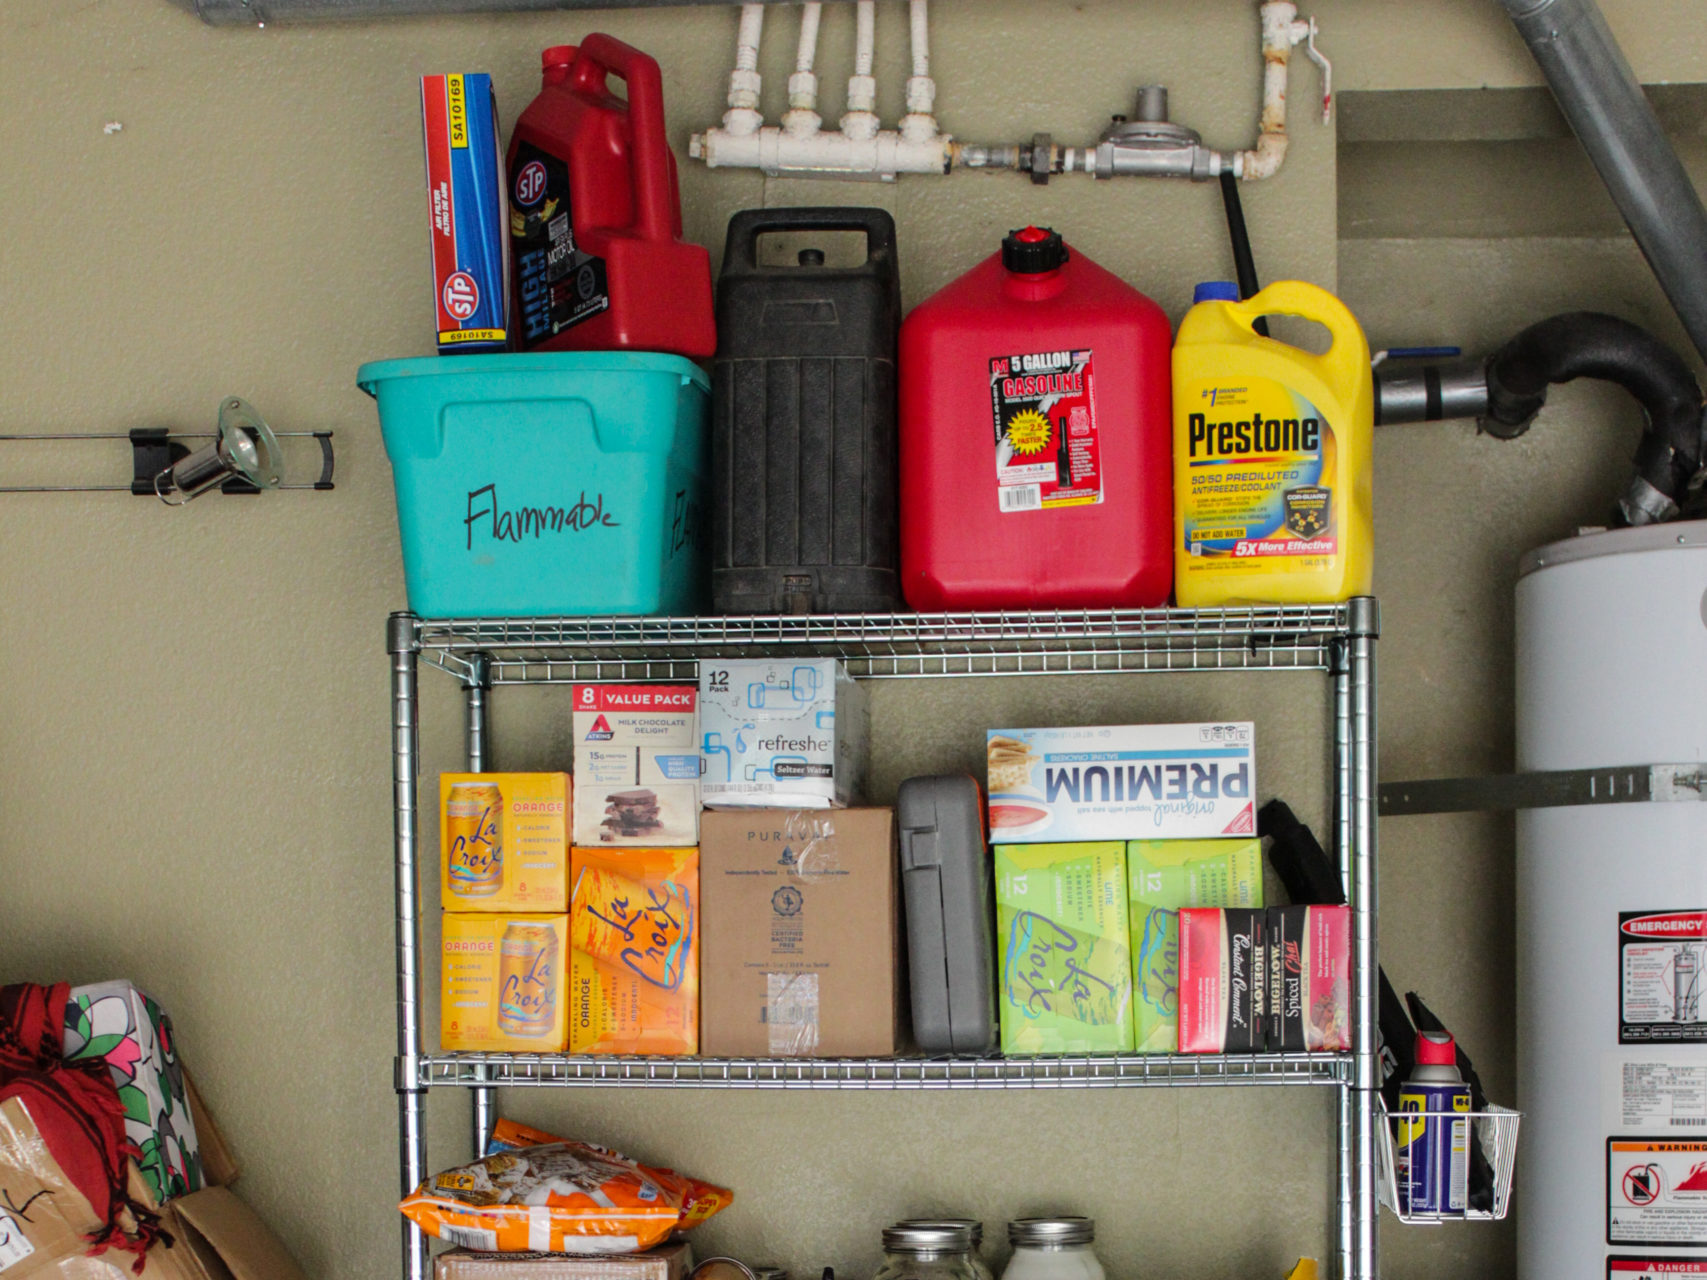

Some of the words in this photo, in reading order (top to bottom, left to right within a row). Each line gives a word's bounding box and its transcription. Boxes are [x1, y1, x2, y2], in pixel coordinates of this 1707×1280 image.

[451, 78, 464, 141] SA10169
[519, 165, 544, 200] STP
[448, 278, 475, 315] STP
[520, 251, 543, 339] HIGH
[450, 331, 494, 341] SA10169
[1012, 357, 1020, 372] 5
[1023, 352, 1071, 371] GALLON
[1003, 373, 1083, 397] GASOLINE
[1189, 413, 1318, 457] Prestone
[1226, 471, 1299, 481] PREDILUTED
[463, 483, 622, 550] Flammable
[1212, 530, 1224, 538] ADD
[1225, 529, 1244, 537] WATER
[1236, 541, 1257, 556] 5X
[1258, 542, 1285, 551] More
[1287, 540, 1332, 550] Effective
[709, 671, 729, 685] 12
[582, 688, 594, 703] 8
[606, 695, 650, 704] VALUE
[654, 695, 690, 704] PACK
[758, 735, 828, 751] refreshe
[777, 766, 805, 774] Seltzer
[807, 766, 830, 774] Water
[1046, 763, 1249, 803] PREMIUM
[513, 803, 562, 812] ORANGE
[1154, 794, 1214, 826] original
[470, 807, 496, 845] La
[1013, 875, 1027, 895] 12
[1105, 882, 1113, 905] LIME
[1147, 872, 1162, 892] 12
[588, 896, 643, 941] La
[1630, 921, 1703, 932] EMERGENCY
[445, 942, 494, 951] ORANGE
[1282, 940, 1302, 973] Chai
[523, 947, 551, 986] La
[1059, 958, 1114, 1001] La
[1254, 946, 1264, 1014] BIGELOW
[1271, 945, 1281, 1015] BIGELOW
[581, 978, 590, 1027] ORANGE
[1286, 978, 1301, 1017] Spiced
[1401, 1101, 1419, 1124] 40
